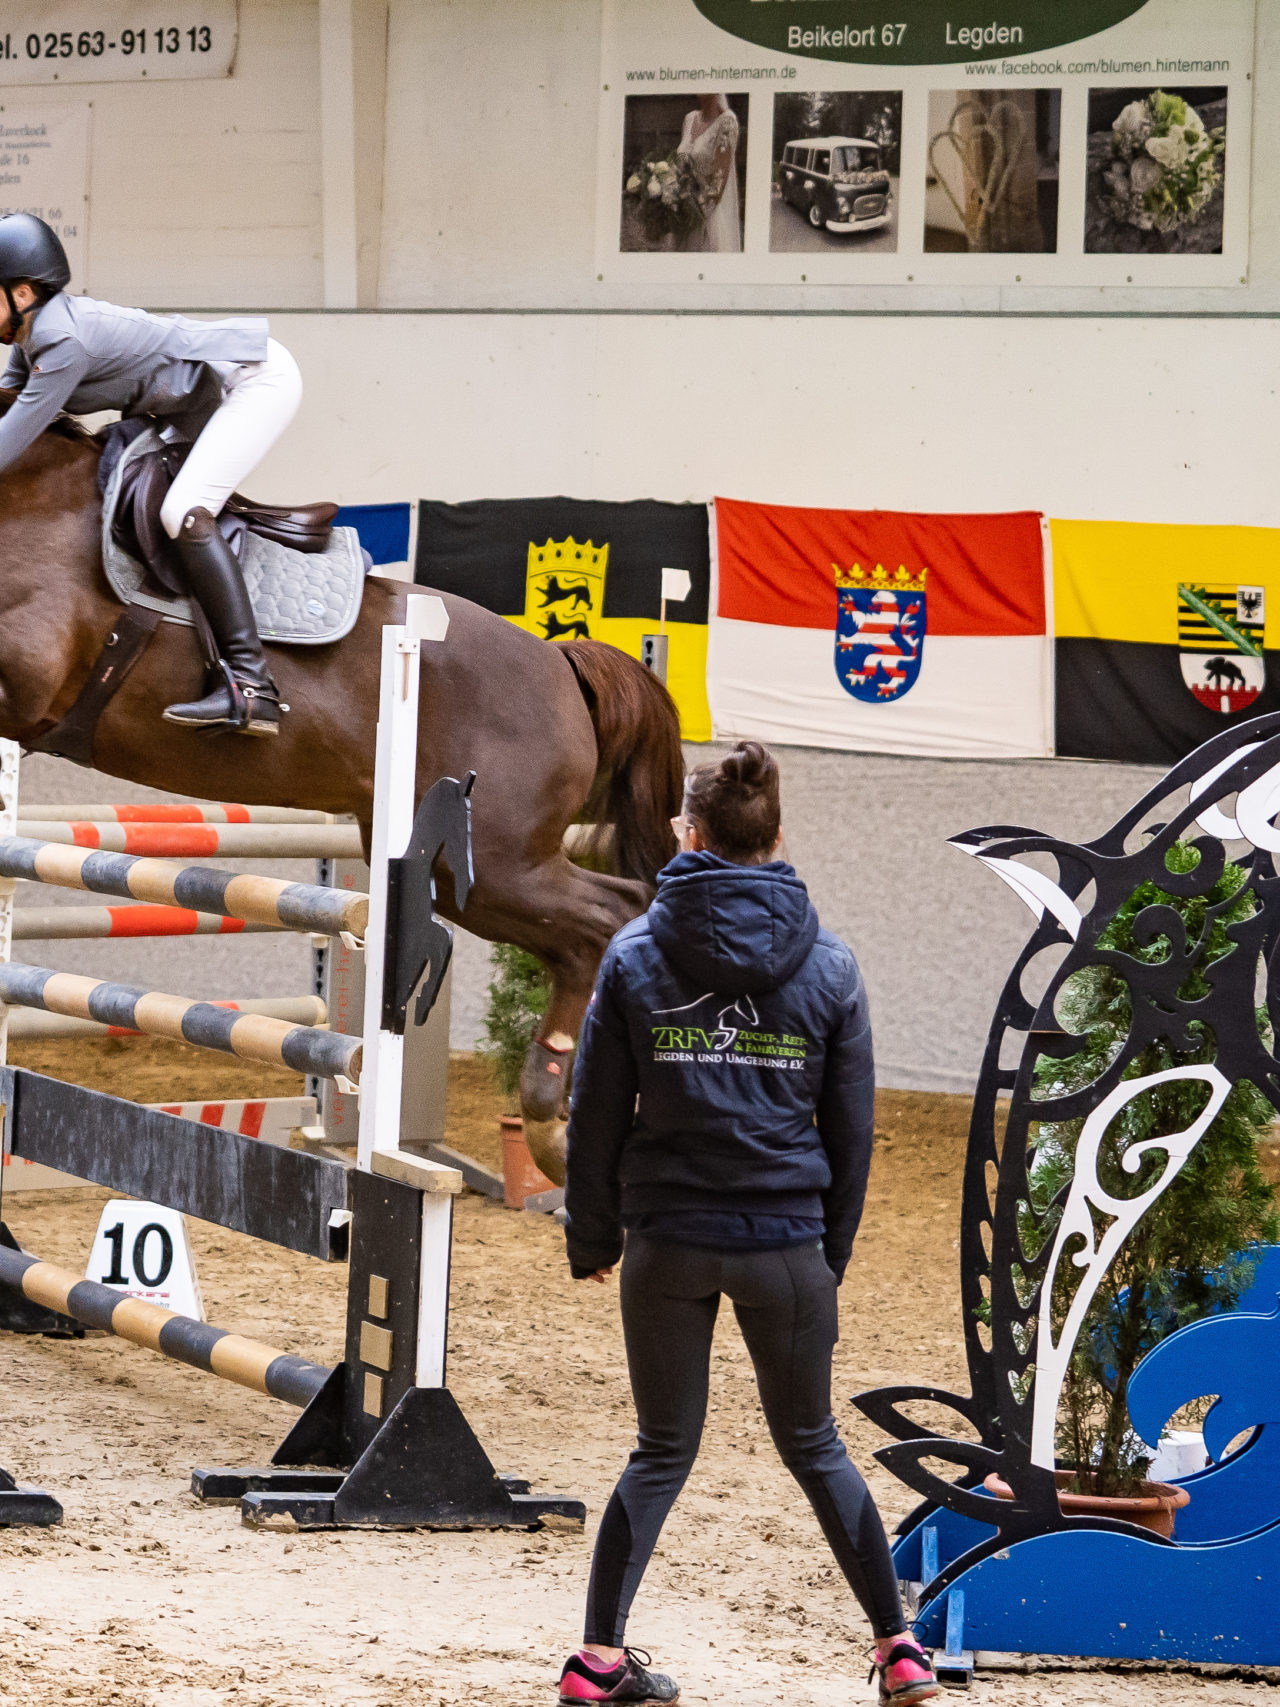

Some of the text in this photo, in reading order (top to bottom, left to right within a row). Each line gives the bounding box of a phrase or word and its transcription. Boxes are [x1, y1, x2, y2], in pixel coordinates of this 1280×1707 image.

[788, 22, 1022, 50] Beikelort 67 Legden
[626, 65, 797, 82] www.blumen-hintemann.de
[965, 59, 1230, 76] www.facebook.com/blumen.hintemann
[653, 1051, 694, 1062] LEGDEN
[698, 1053, 722, 1063] UND
[725, 1052, 787, 1068] UMGEBUNG
[101, 1222, 173, 1287] 10
